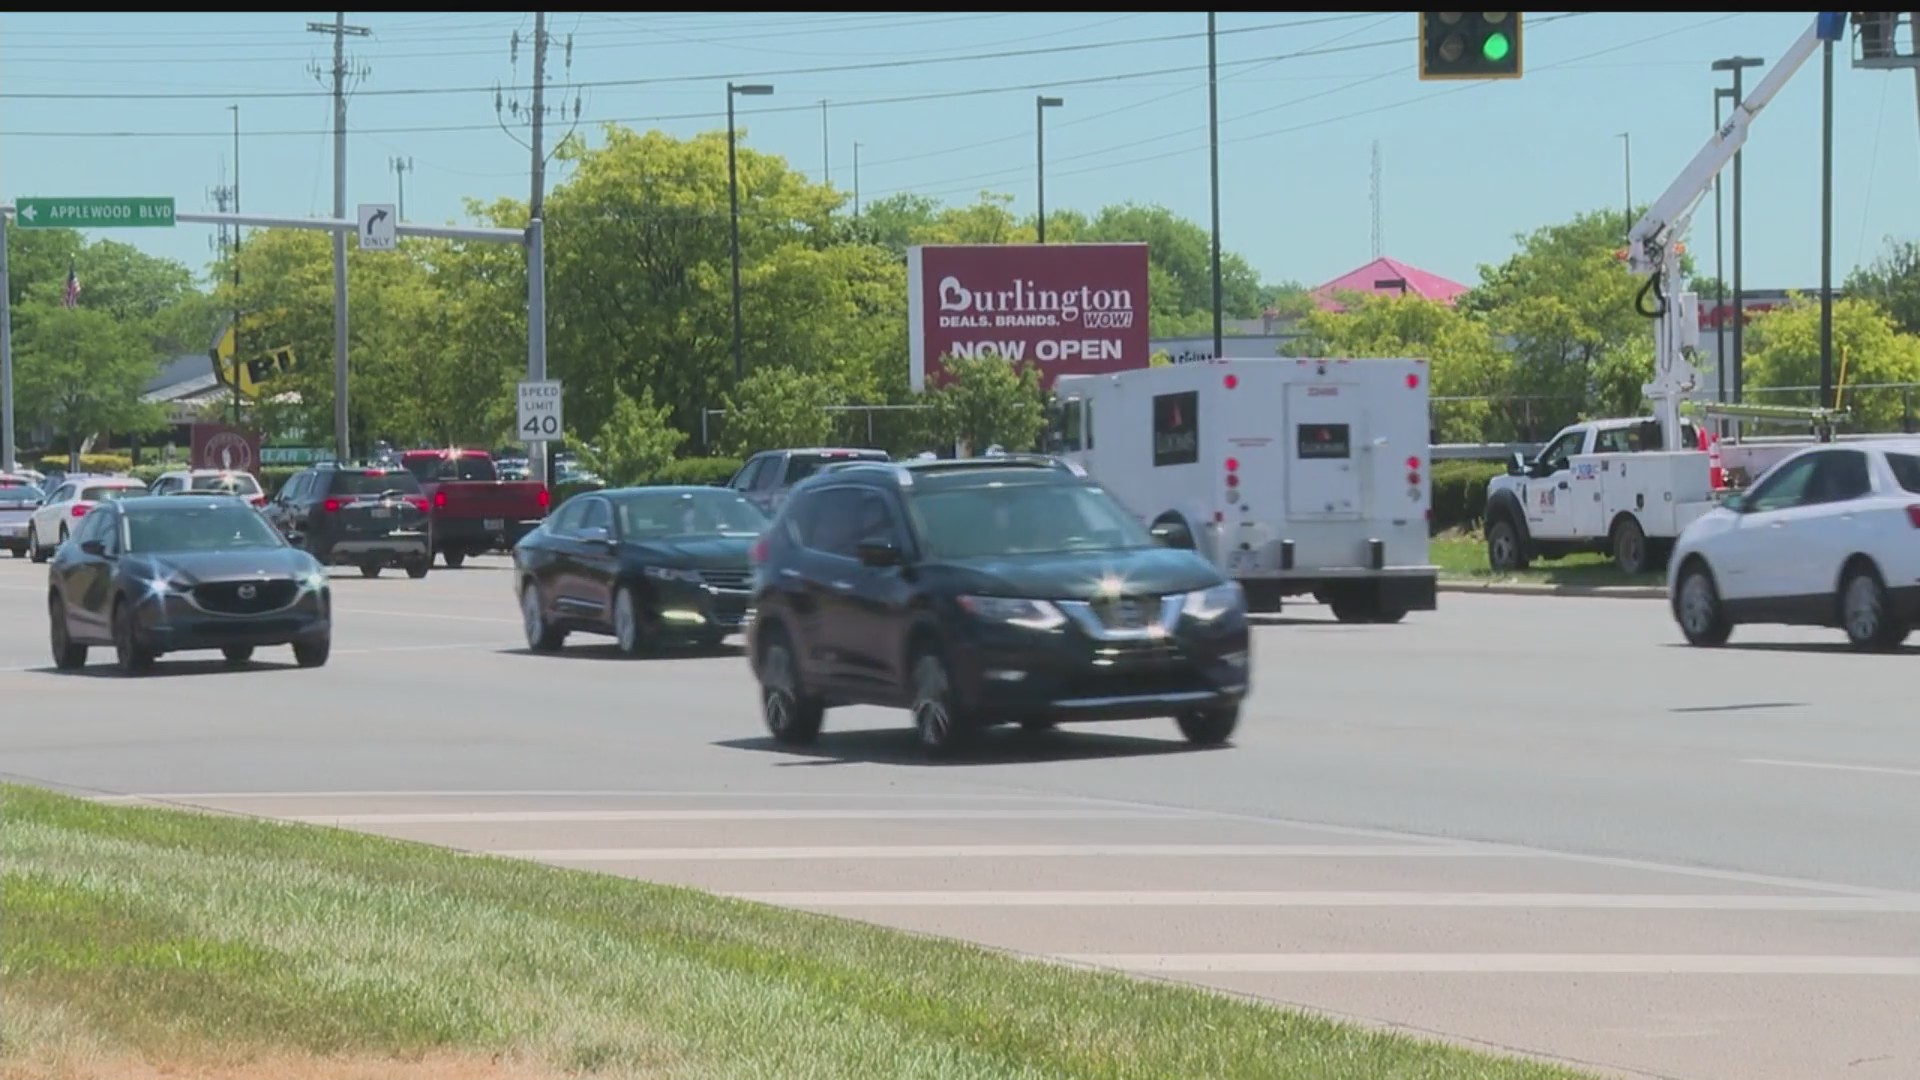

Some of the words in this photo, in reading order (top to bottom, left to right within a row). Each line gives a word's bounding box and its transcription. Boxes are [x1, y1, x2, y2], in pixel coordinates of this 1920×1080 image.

[50, 205, 131, 218] APPLEWOOD
[139, 204, 171, 218] BLVD
[364, 236, 390, 246] ONLY
[939, 276, 1133, 322] Burlington
[940, 316, 992, 328] DEALS.
[996, 315, 1060, 327] BRANDS.
[1084, 311, 1133, 328] WOW!
[951, 341, 1025, 360] NOW
[1035, 340, 1122, 360] OPEN
[522, 387, 558, 397] SPEED
[525, 401, 553, 411] LIMIT
[523, 415, 557, 435] 40
